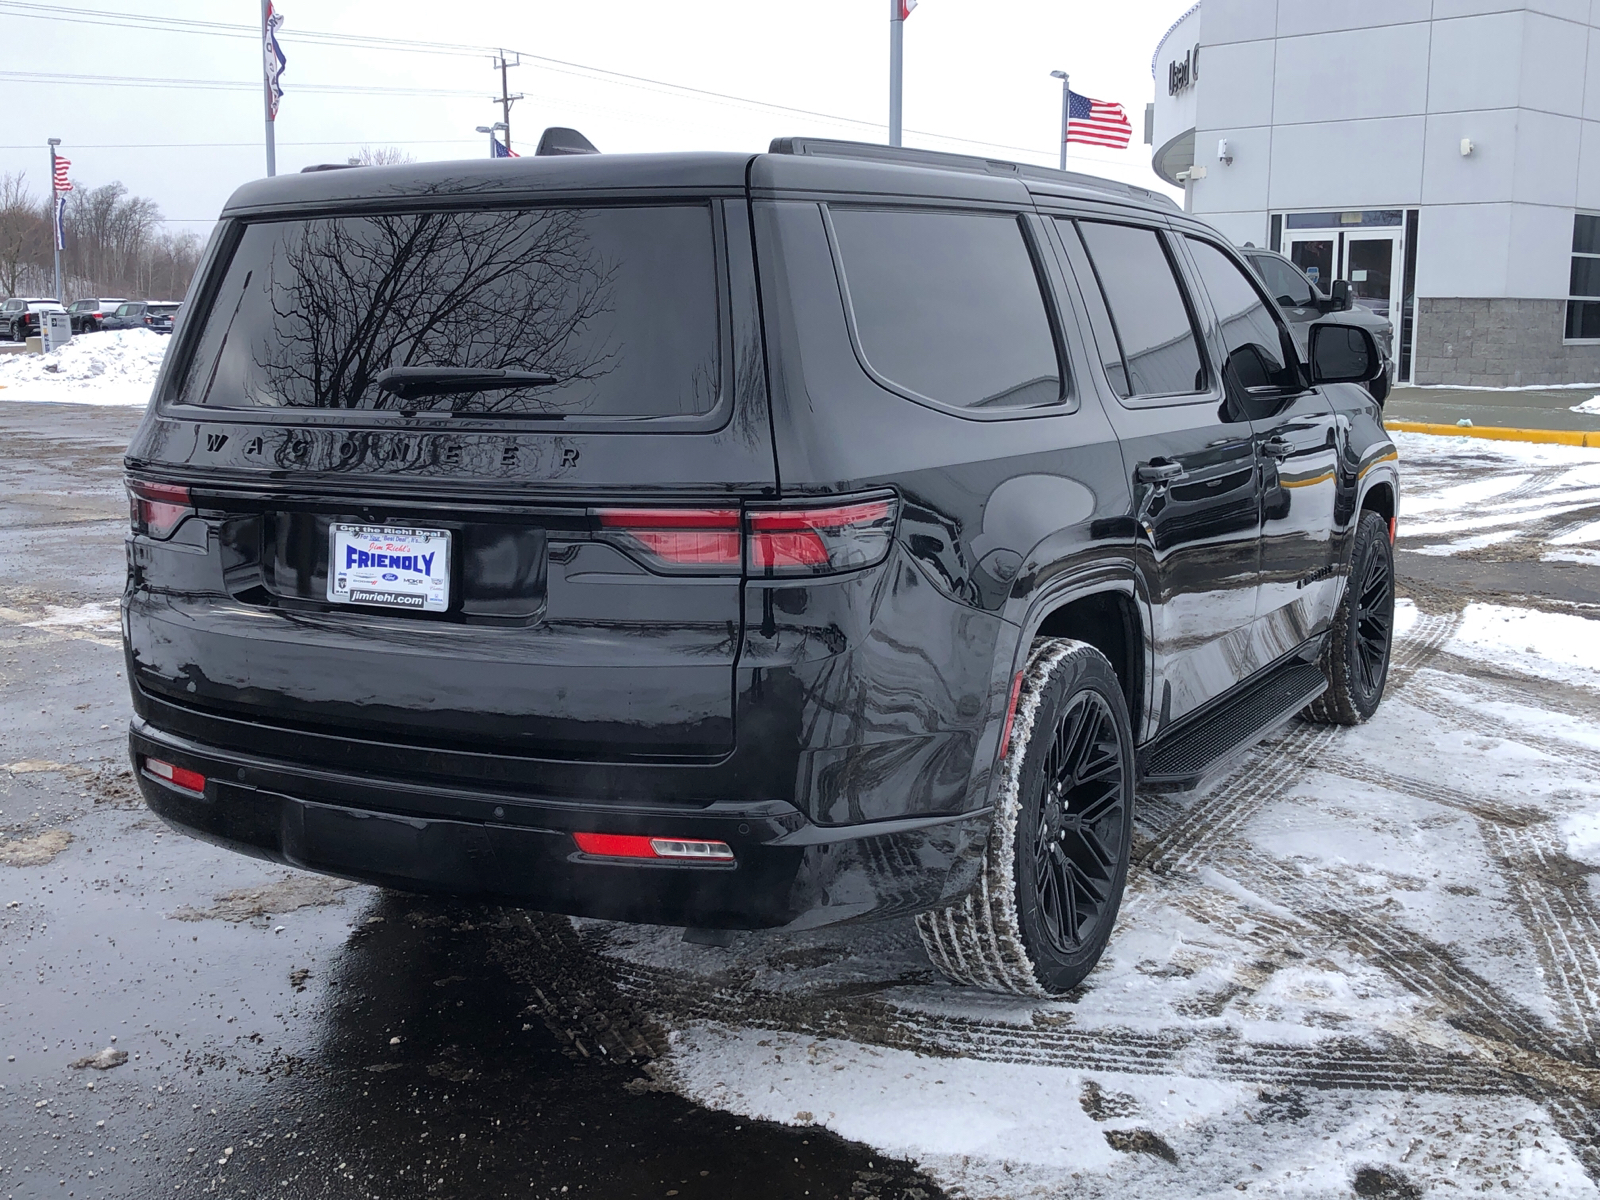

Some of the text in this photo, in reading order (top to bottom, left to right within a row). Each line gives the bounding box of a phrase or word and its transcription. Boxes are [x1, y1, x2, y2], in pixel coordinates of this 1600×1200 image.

[1169, 50, 1190, 96] Used
[206, 433, 580, 468] WAGONEER
[346, 544, 436, 577] FRIENDLY
[368, 542, 411, 553] Jim Riehl's
[351, 591, 423, 605] jimriehl.com
